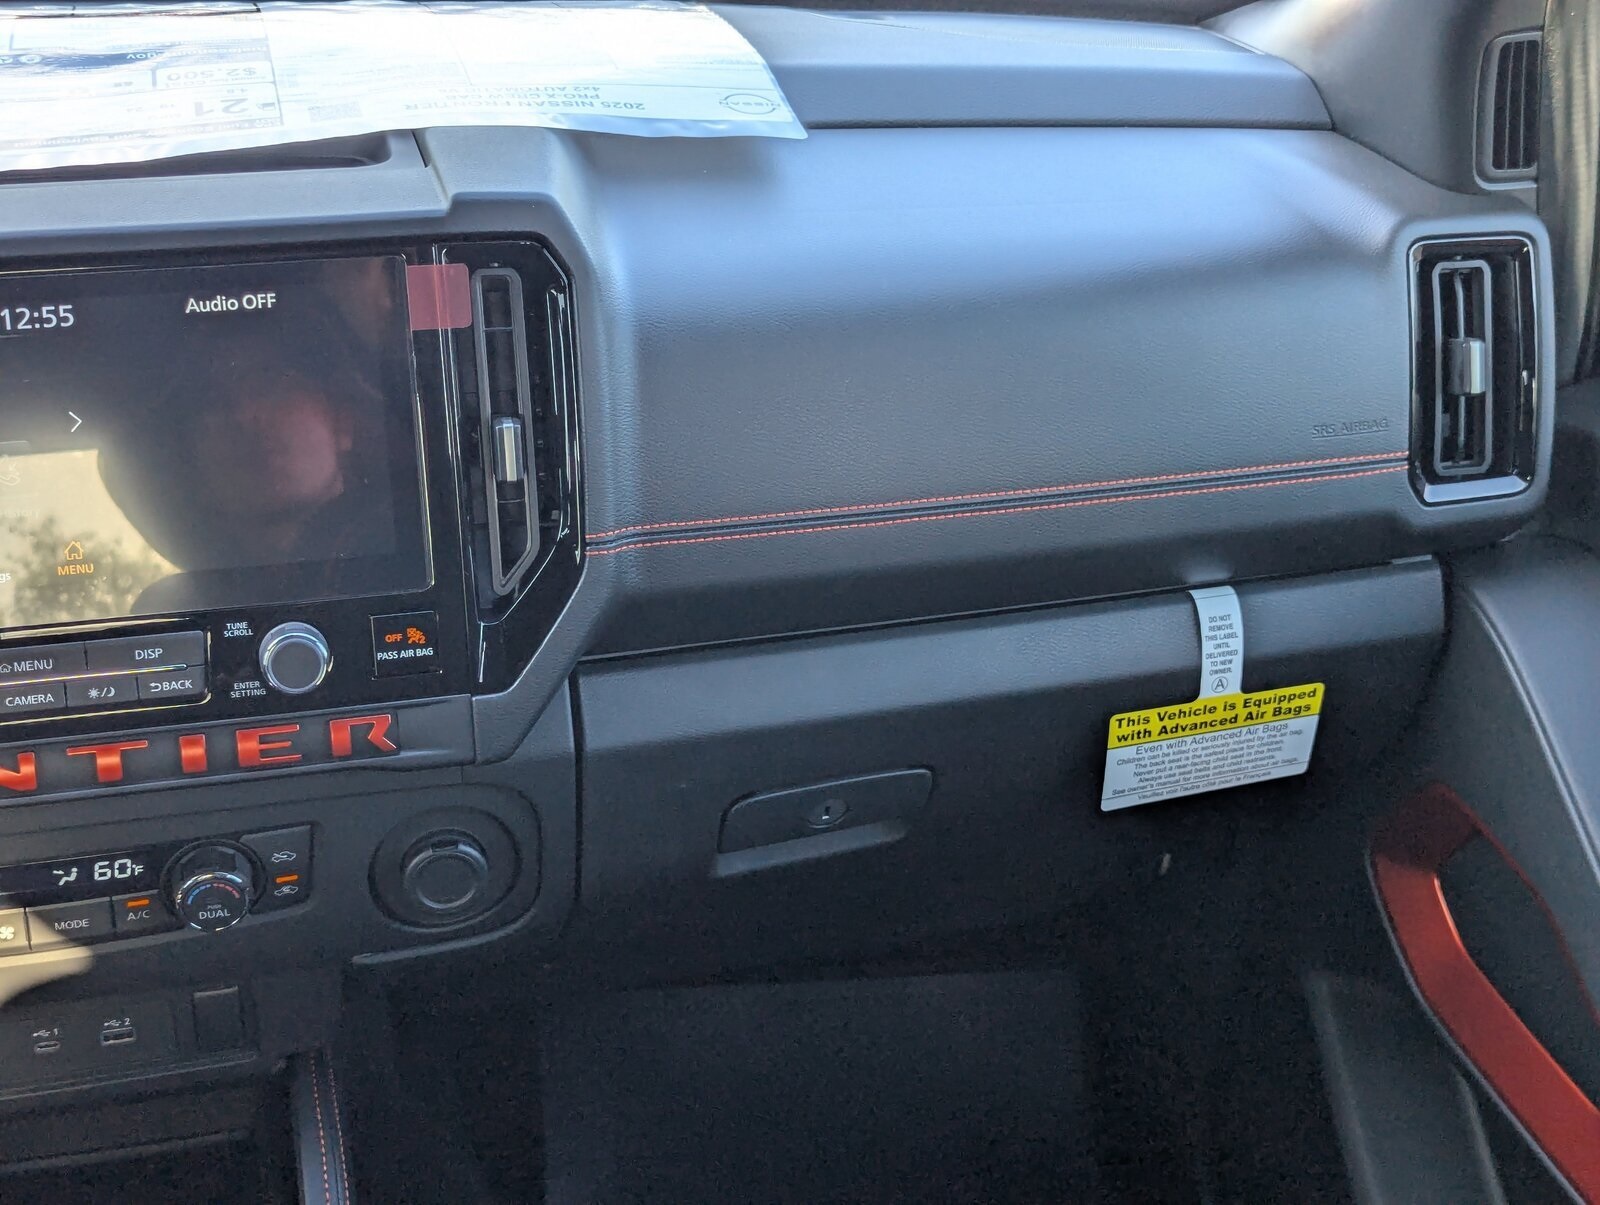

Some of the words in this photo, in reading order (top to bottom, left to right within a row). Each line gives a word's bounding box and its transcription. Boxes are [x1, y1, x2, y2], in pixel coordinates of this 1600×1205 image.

[193, 98, 249, 117] 21
[405, 100, 511, 110] FRONTIER
[518, 100, 595, 108] NISSAN
[601, 101, 645, 110] 2025
[185, 295, 239, 314] Audio
[242, 293, 276, 310] OFF
[0, 304, 75, 331] 12:55
[1311, 423, 1336, 436] SRS
[1341, 417, 1389, 432] AIRBAG
[57, 563, 94, 577] MENU
[223, 627, 254, 638] SCROLL
[225, 622, 249, 632] TUNE
[1208, 623, 1234, 632] REMOVE
[384, 633, 403, 643] OFF
[1219, 632, 1238, 640] LABEL
[134, 647, 163, 661] DISP
[377, 651, 398, 660] PASS
[400, 650, 414, 658] AIR
[416, 647, 434, 656] BAG
[1205, 649, 1238, 660] DELIVERED
[14, 658, 53, 673] MENU
[162, 678, 193, 692] BACK
[233, 681, 261, 691] ENTER
[229, 687, 267, 699] SETTING
[5, 692, 55, 708] CAMERA
[1116, 715, 1150, 729] This
[1157, 704, 1217, 722] Vehicle
[1222, 701, 1236, 712] is
[1242, 688, 1317, 708] Equipped
[1116, 728, 1152, 743] with
[1157, 714, 1238, 736] Advanced
[1243, 710, 1268, 722] Air
[1271, 704, 1312, 717] Bags
[1136, 744, 1163, 755] Even
[1166, 740, 1187, 750] with
[1189, 729, 1242, 746] Advanced
[1244, 727, 1260, 736] Air
[1262, 722, 1288, 733] Bags
[1116, 756, 1146, 766] Children
[1172, 748, 1190, 756] killed
[1232, 737, 1255, 746] injured
[1149, 760, 1166, 768] back
[1133, 769, 1154, 778] Never
[1138, 775, 1162, 784] Always
[127, 909, 151, 920] A/C
[199, 908, 231, 920] DUAL
[54, 918, 90, 931] MODE
[124, 1018, 131, 1026] 2
